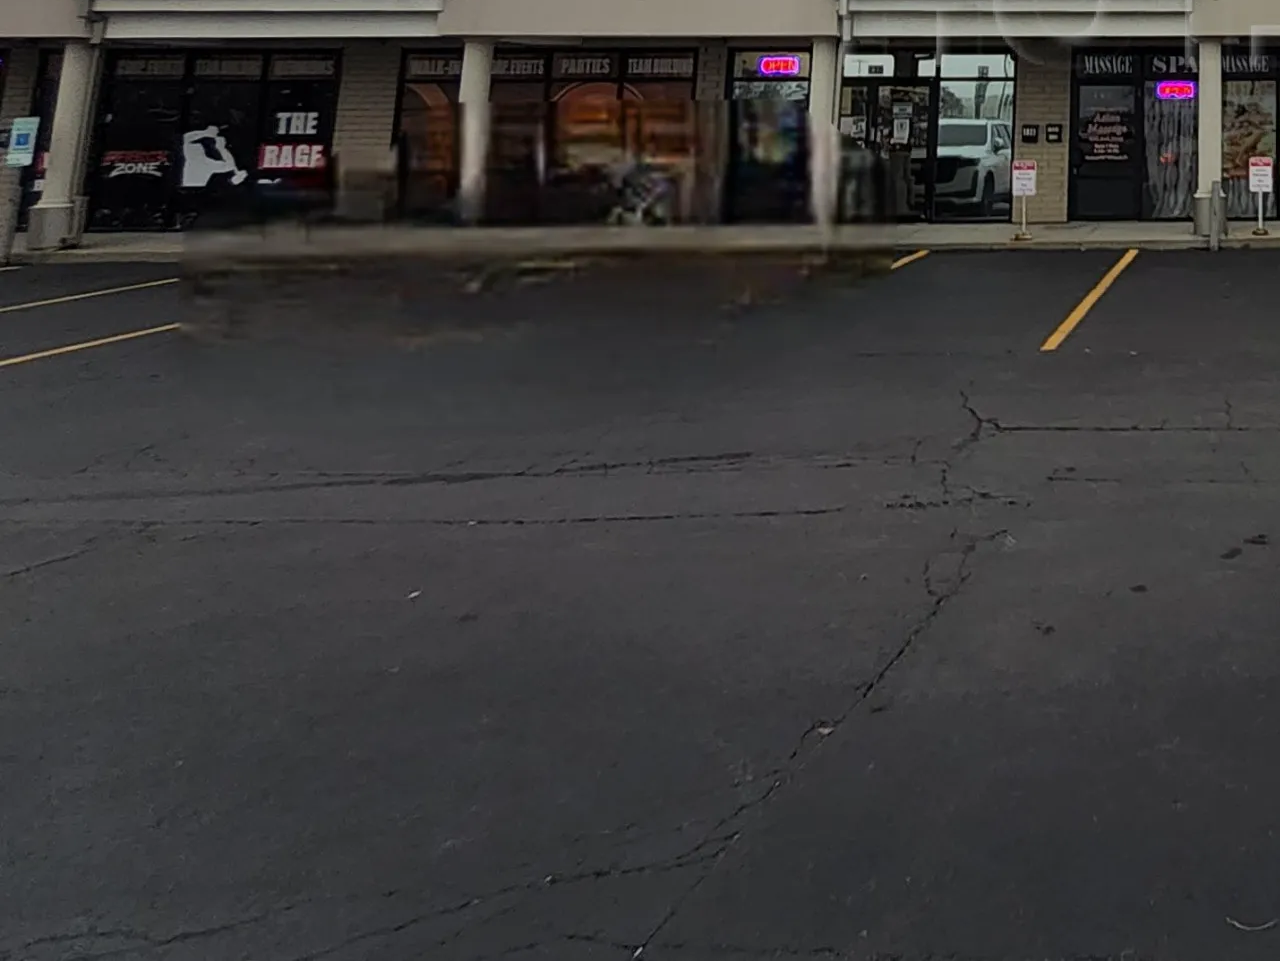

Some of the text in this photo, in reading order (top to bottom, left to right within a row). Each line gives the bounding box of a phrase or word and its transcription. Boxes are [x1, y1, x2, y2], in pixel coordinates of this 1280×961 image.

[561, 58, 611, 74] PARTIES
[763, 59, 797, 72] OPEN
[1084, 55, 1199, 74] MASSAGE SPA
[1221, 55, 1269, 73] MASSAGE
[276, 112, 319, 134] THE
[263, 144, 325, 168] RAGE
[108, 161, 163, 178] ZONE
